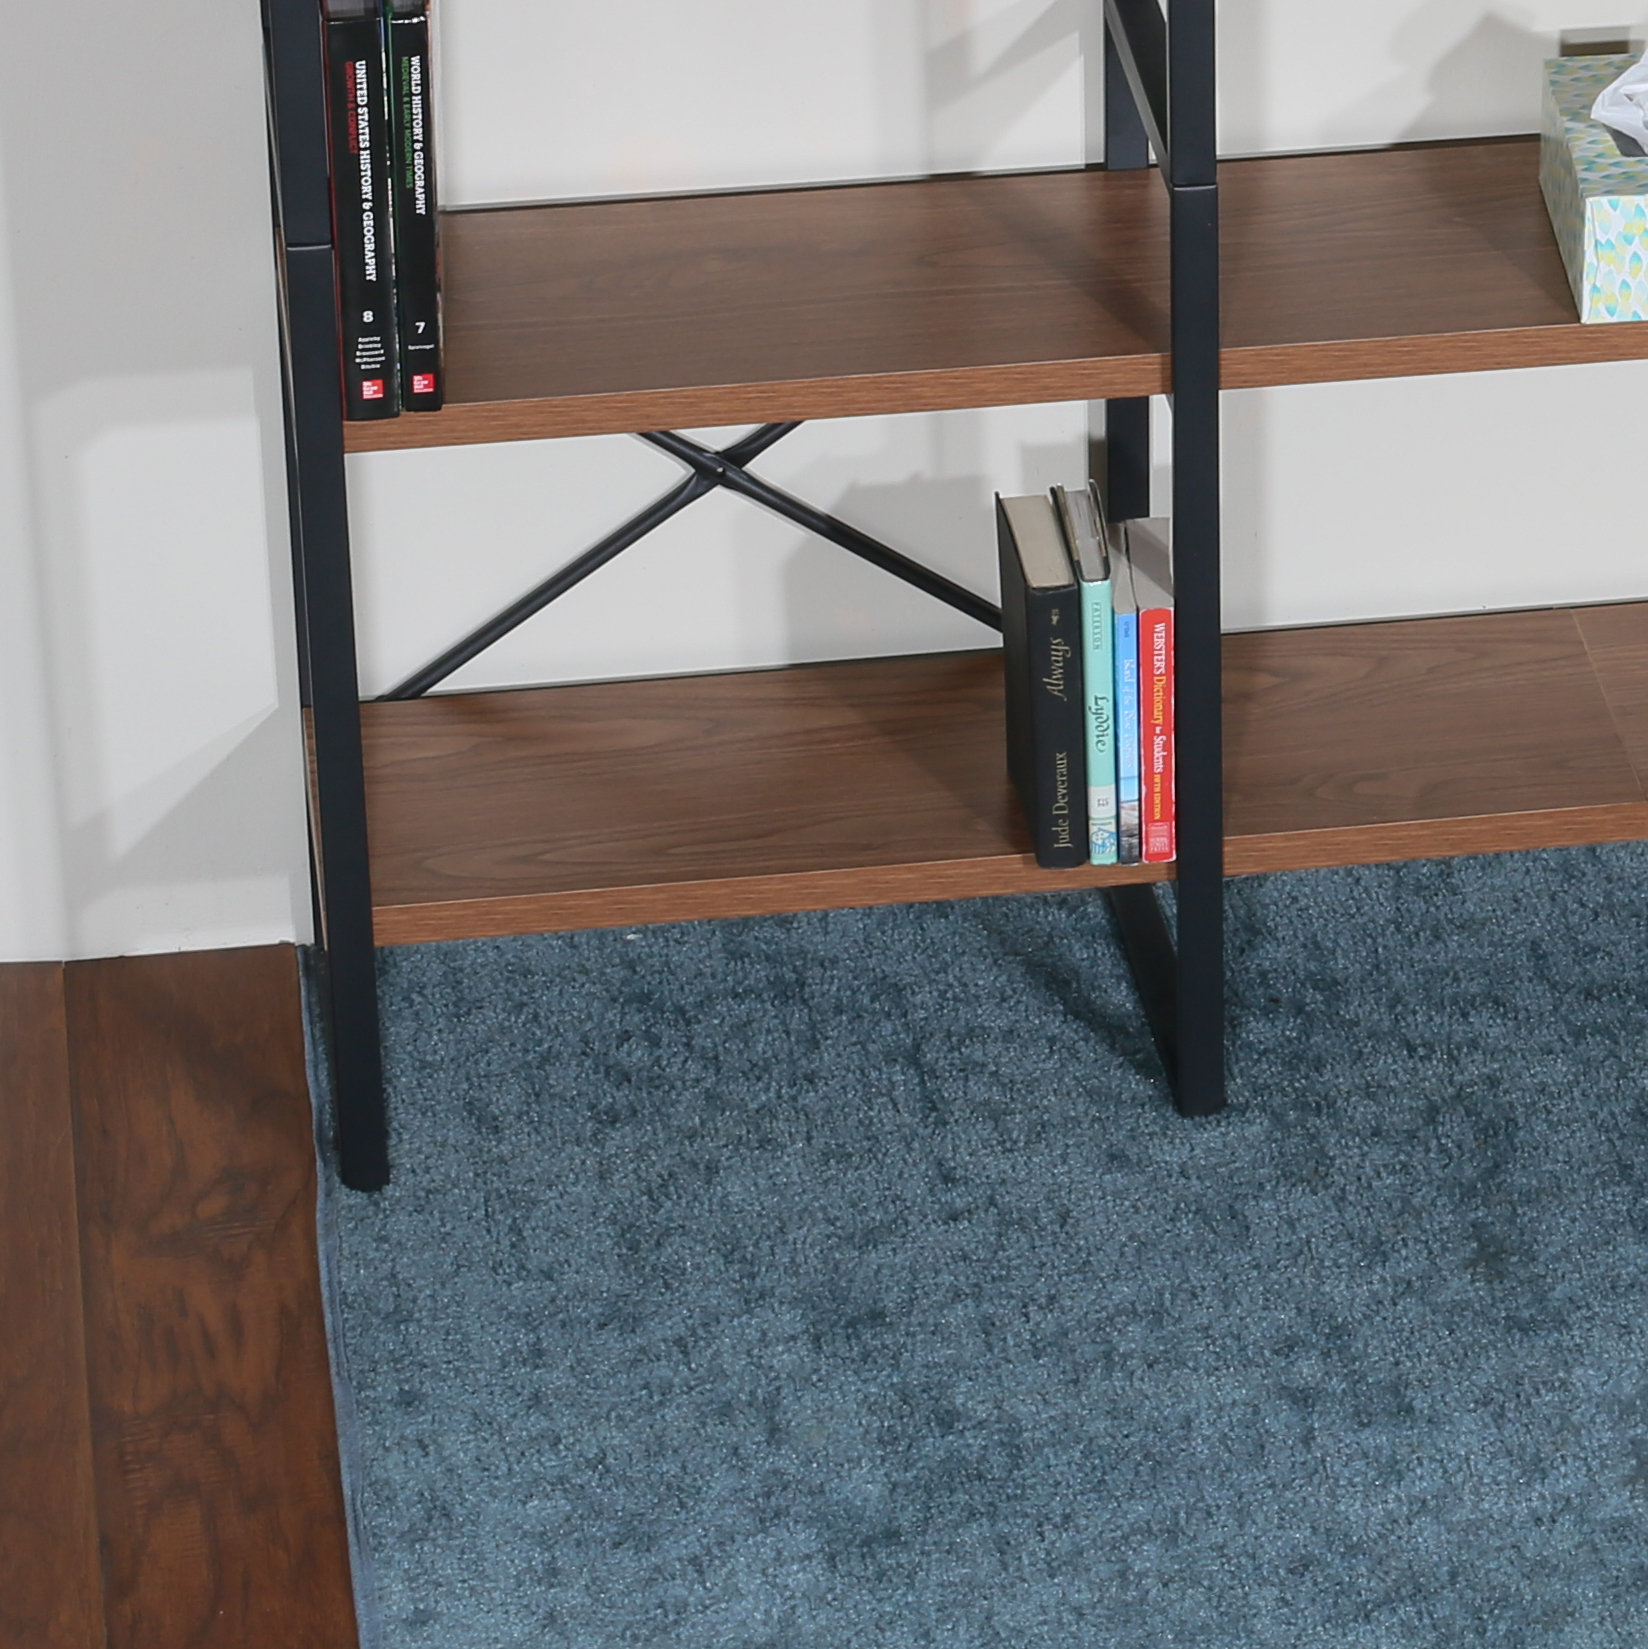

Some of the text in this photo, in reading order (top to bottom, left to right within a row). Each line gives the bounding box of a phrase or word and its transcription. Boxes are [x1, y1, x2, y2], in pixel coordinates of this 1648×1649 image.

[401, 56, 411, 95] MEDIEVAL
[402, 103, 412, 128] EARLY
[410, 55, 427, 215] WORLD HISTORY & GEOGRAPHY
[403, 129, 413, 164] MODERN
[355, 60, 377, 282] UNITED STATES HISTORY & GEOGRAPHY
[404, 165, 414, 189] TIMES
[362, 310, 374, 323] 8
[415, 322, 426, 334] 7
[1092, 602, 1102, 650] PATERSON
[1153, 622, 1166, 675] WEBSTER'S
[1042, 637, 1071, 702] Always
[1088, 695, 1110, 753] Lyddie
[1151, 676, 1167, 725] Dictionary
[1153, 735, 1168, 774] Students
[1051, 752, 1073, 848] Jude Deveraux
